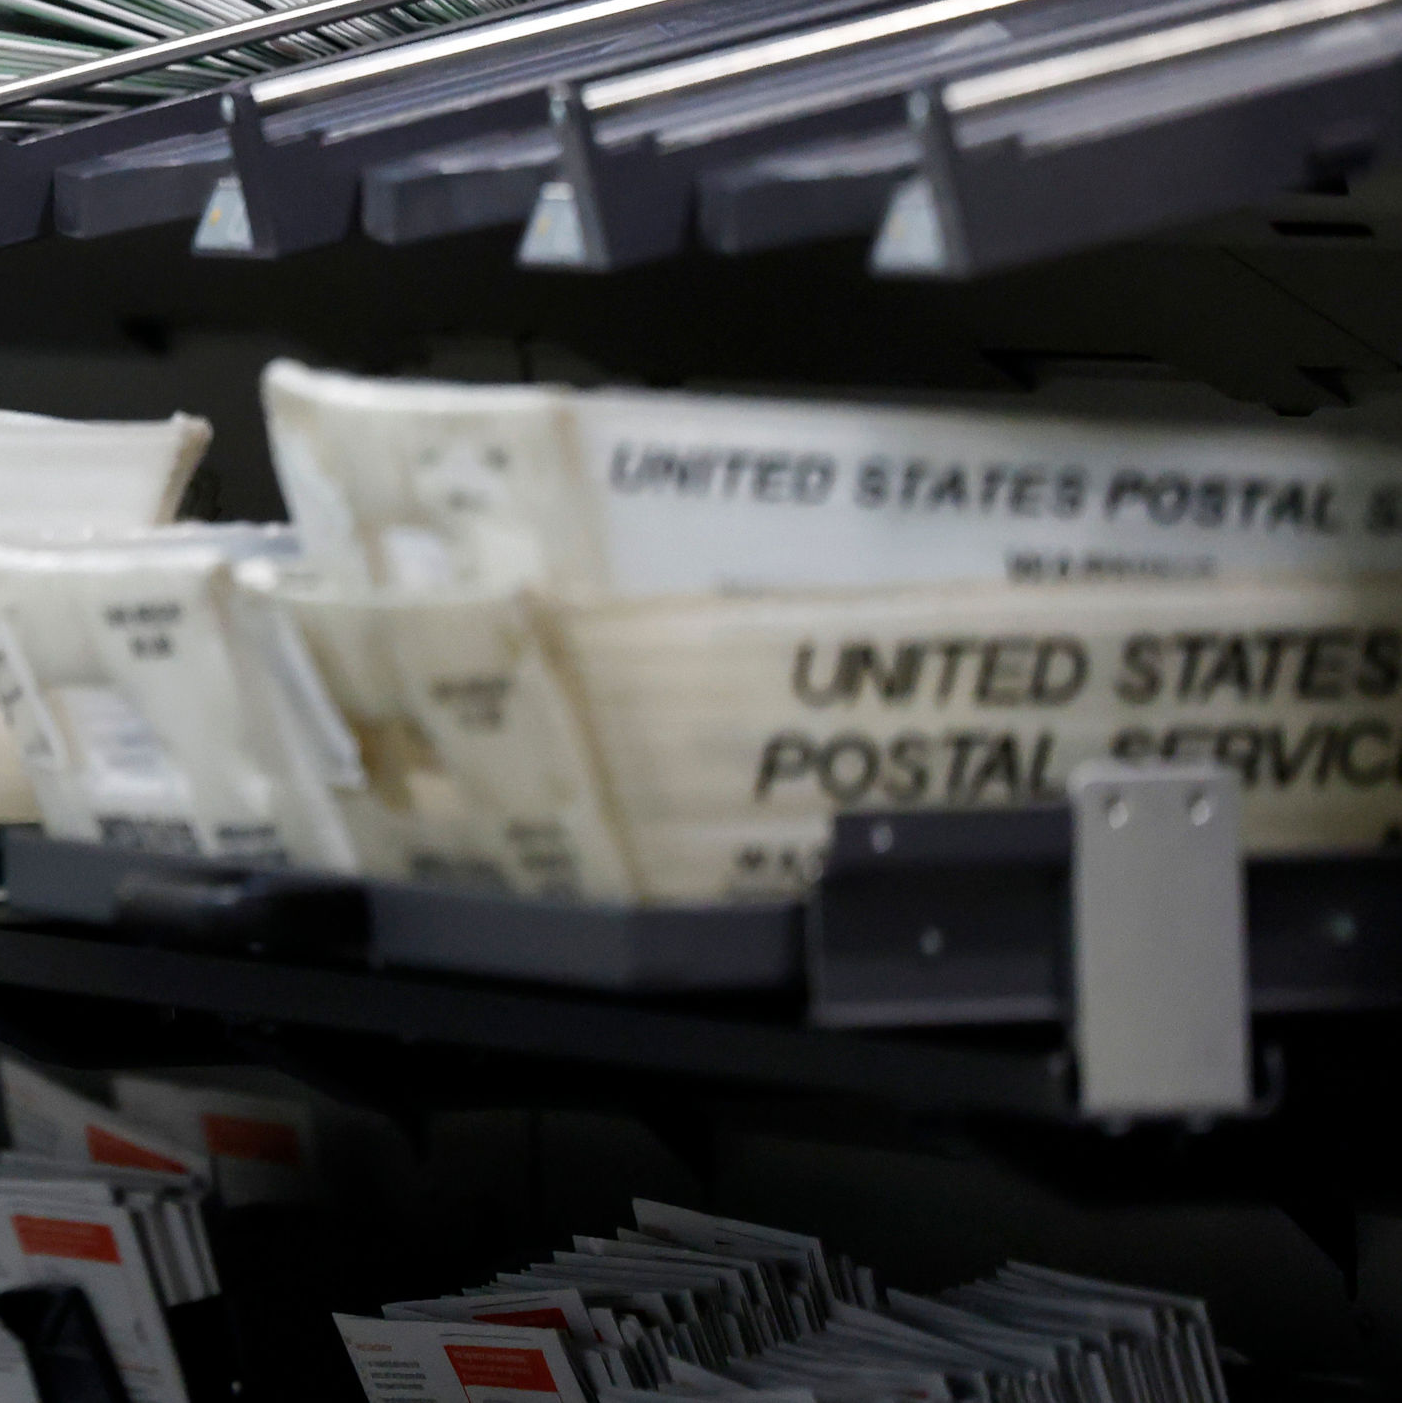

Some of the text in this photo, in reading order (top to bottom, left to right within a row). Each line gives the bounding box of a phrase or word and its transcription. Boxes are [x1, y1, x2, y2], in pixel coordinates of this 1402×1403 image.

[608, 442, 838, 506] UNITED
[855, 454, 1086, 519] STATES
[1105, 467, 1338, 535] POSTAL
[794, 628, 1400, 706] UNITED STATES
[755, 730, 1068, 802] POSTAL
